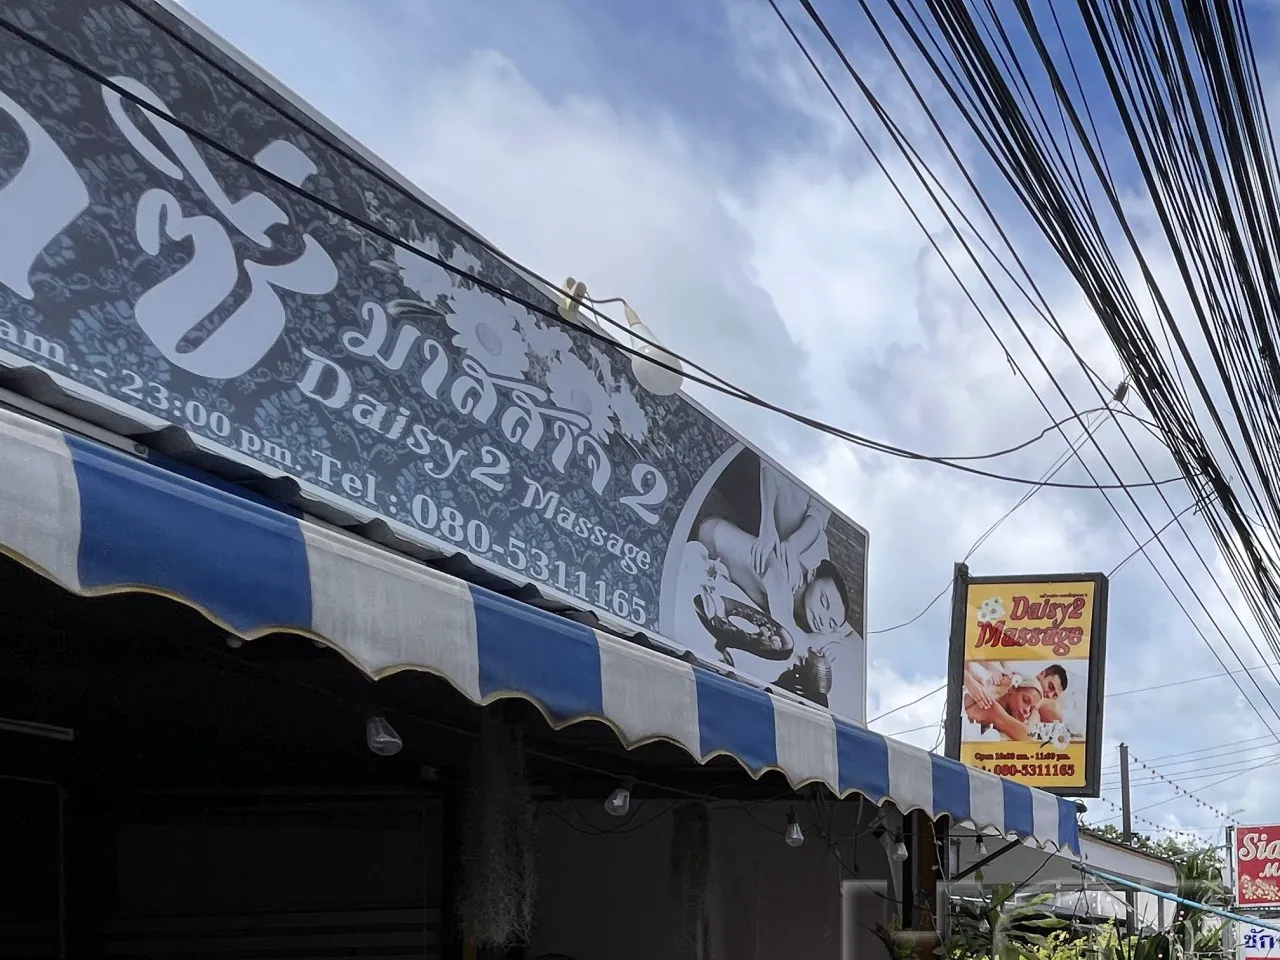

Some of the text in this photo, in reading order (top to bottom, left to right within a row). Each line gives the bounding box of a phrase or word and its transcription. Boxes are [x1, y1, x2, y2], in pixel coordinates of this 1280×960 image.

[121, 369, 231, 437] 23:00
[240, 428, 302, 471] pm.
[411, 494, 647, 625] 080-5311165
[521, 476, 651, 575] Massage
[619, 463, 669, 525] 2
[974, 620, 1084, 657] Massage
